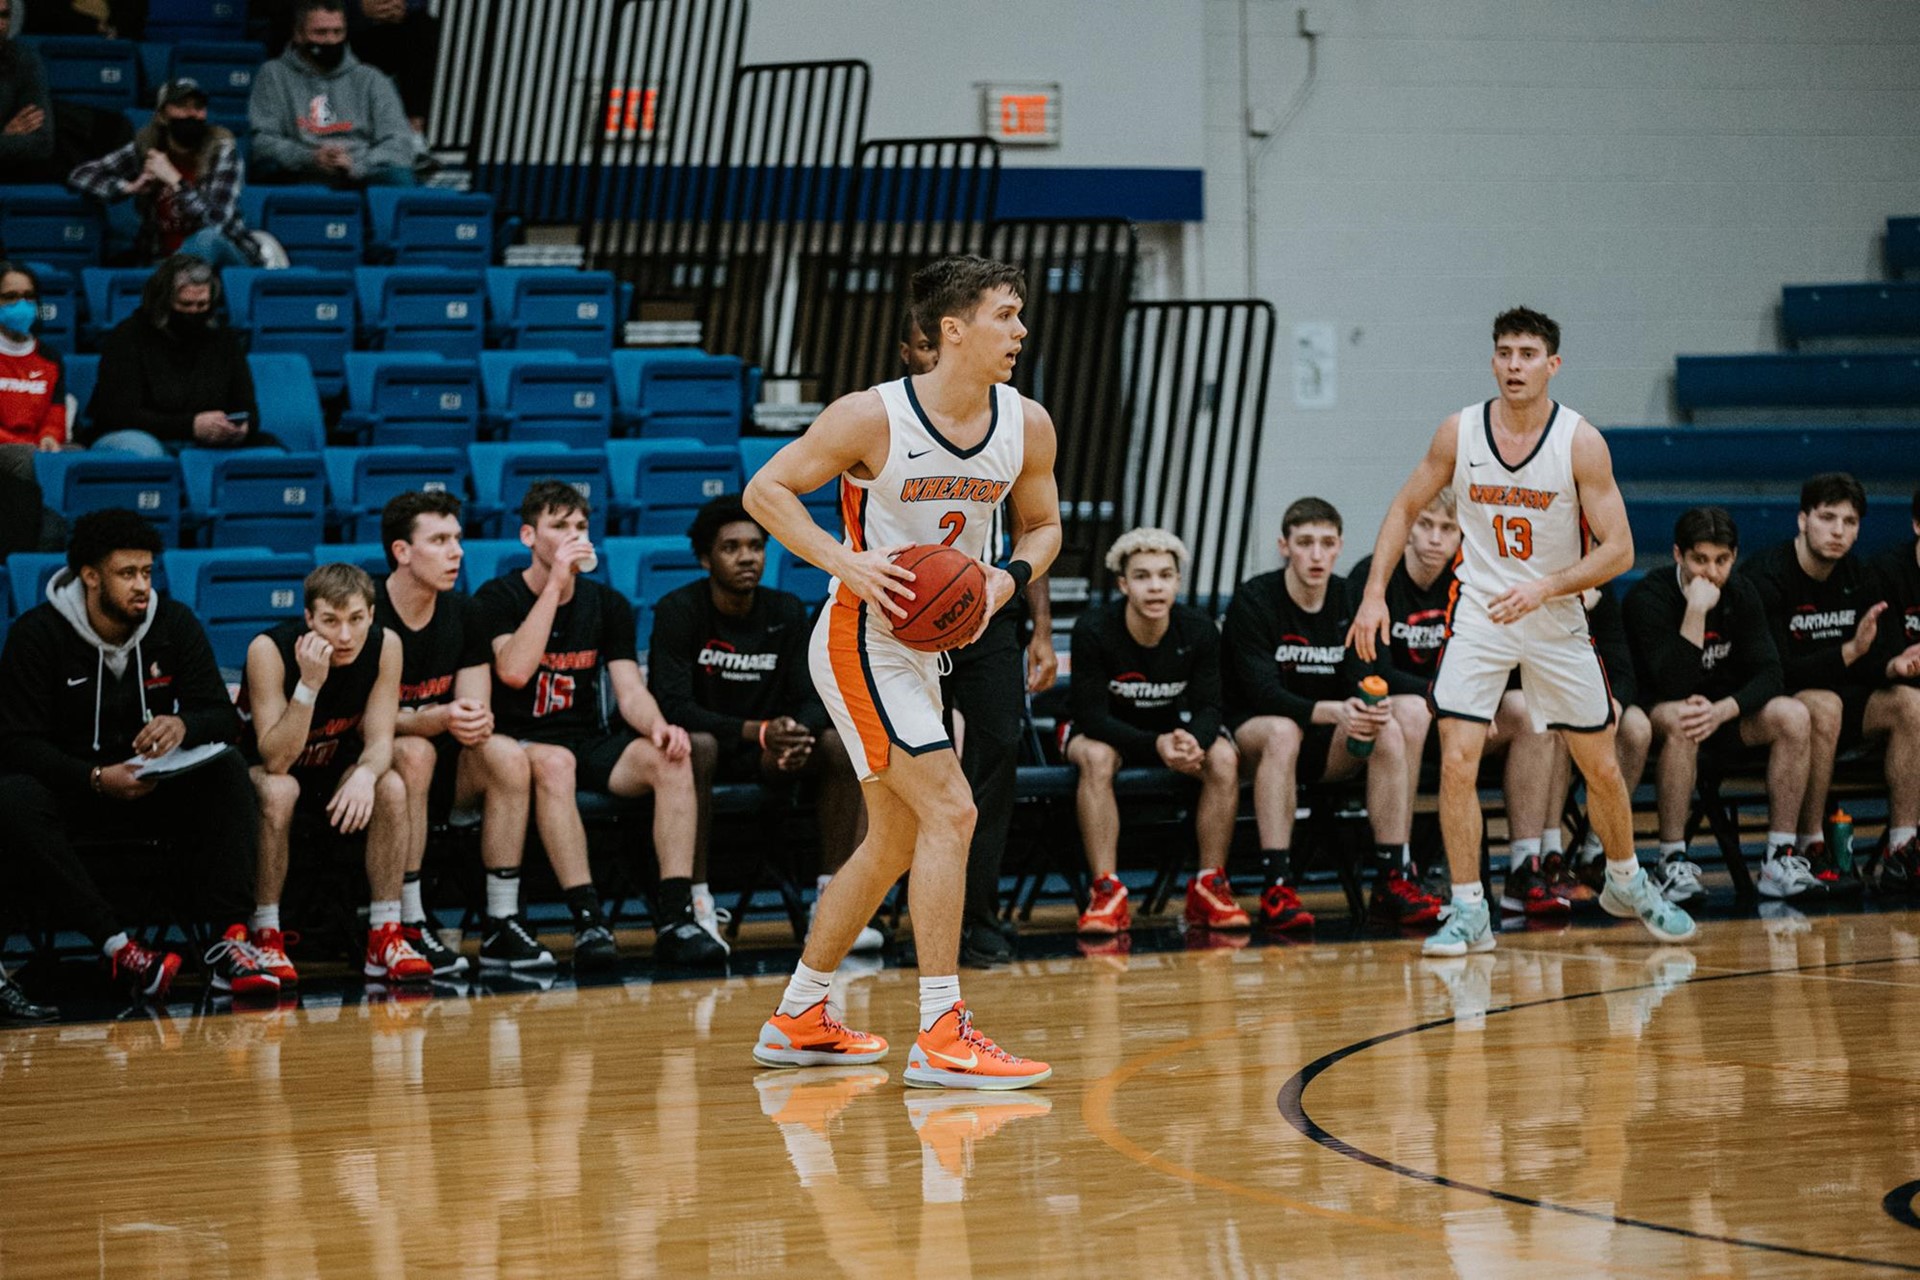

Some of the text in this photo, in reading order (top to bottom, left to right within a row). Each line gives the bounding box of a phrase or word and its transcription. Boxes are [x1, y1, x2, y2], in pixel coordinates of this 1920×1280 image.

[901, 476, 1010, 503] WHEATON
[938, 511, 967, 547] 2
[1492, 514, 1533, 561] 13
[533, 671, 576, 718] 15
